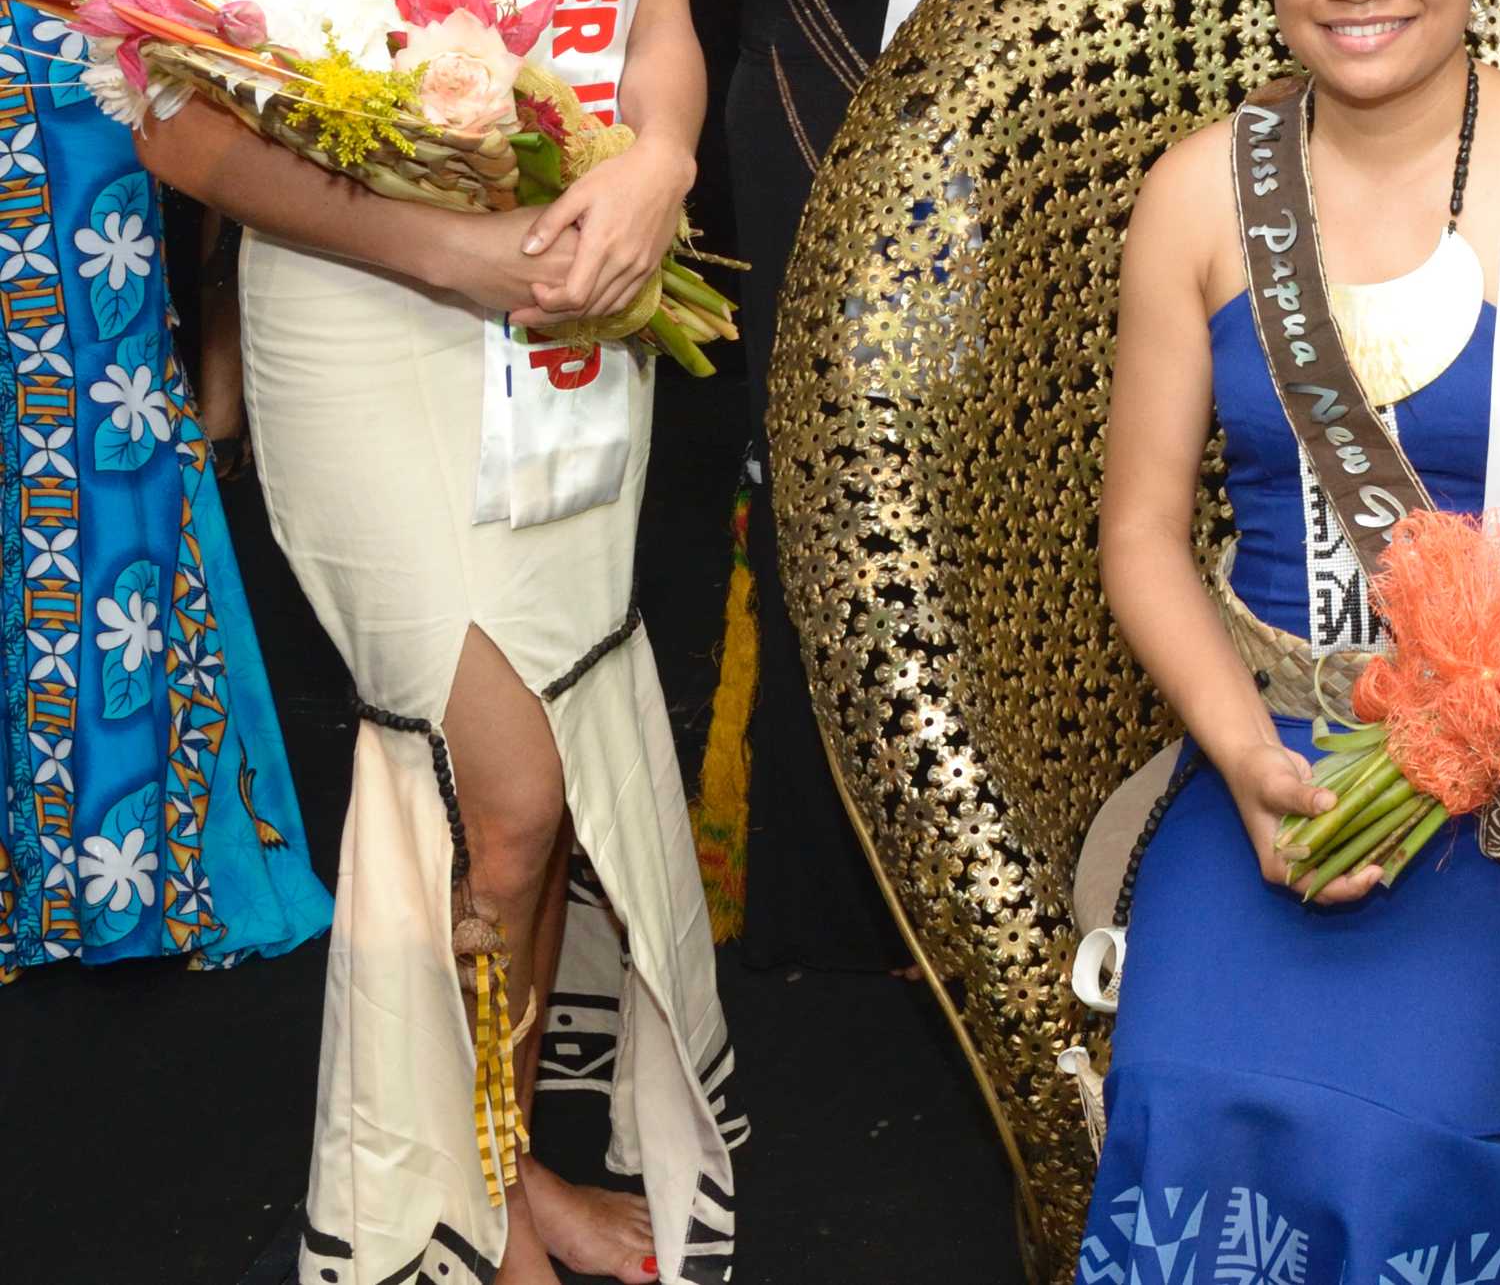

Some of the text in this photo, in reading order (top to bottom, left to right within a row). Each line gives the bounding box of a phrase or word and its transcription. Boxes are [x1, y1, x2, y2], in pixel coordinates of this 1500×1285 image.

[1242, 105, 1281, 196] Miss
[1248, 208, 1318, 367] Papua
[1284, 381, 1371, 475] New
